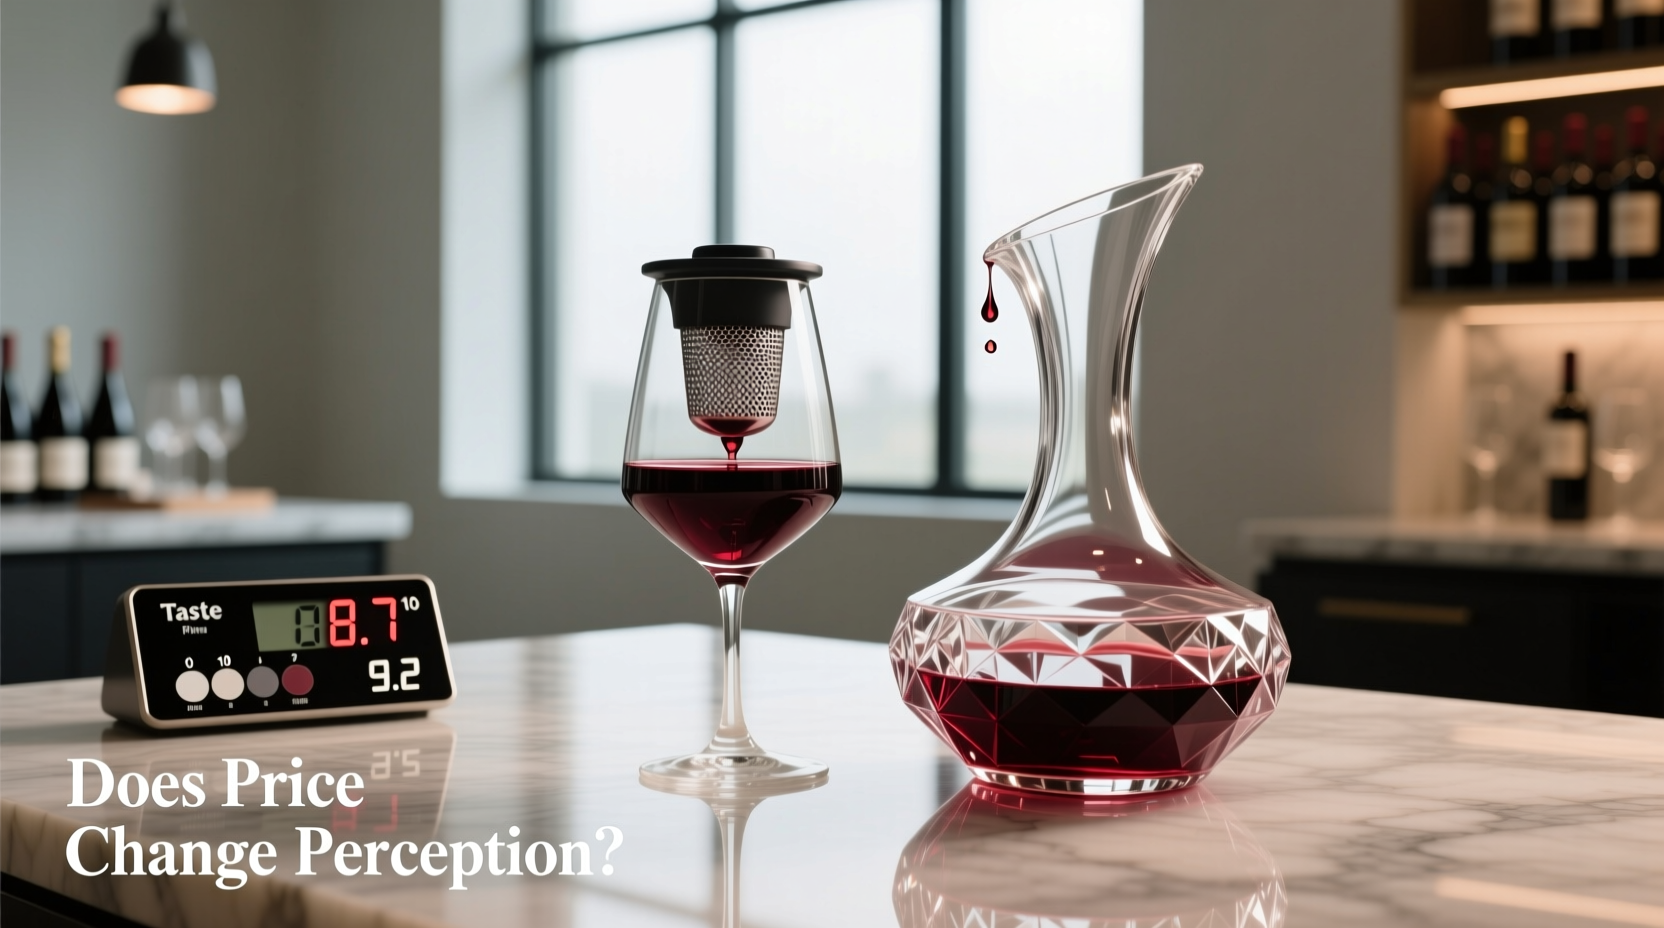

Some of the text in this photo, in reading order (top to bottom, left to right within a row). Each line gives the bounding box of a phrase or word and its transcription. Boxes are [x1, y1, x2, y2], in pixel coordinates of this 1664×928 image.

[160, 601, 222, 622] Taste
[401, 596, 420, 611] 10
[217, 654, 231, 667] 10
[368, 657, 421, 693] 9.2
